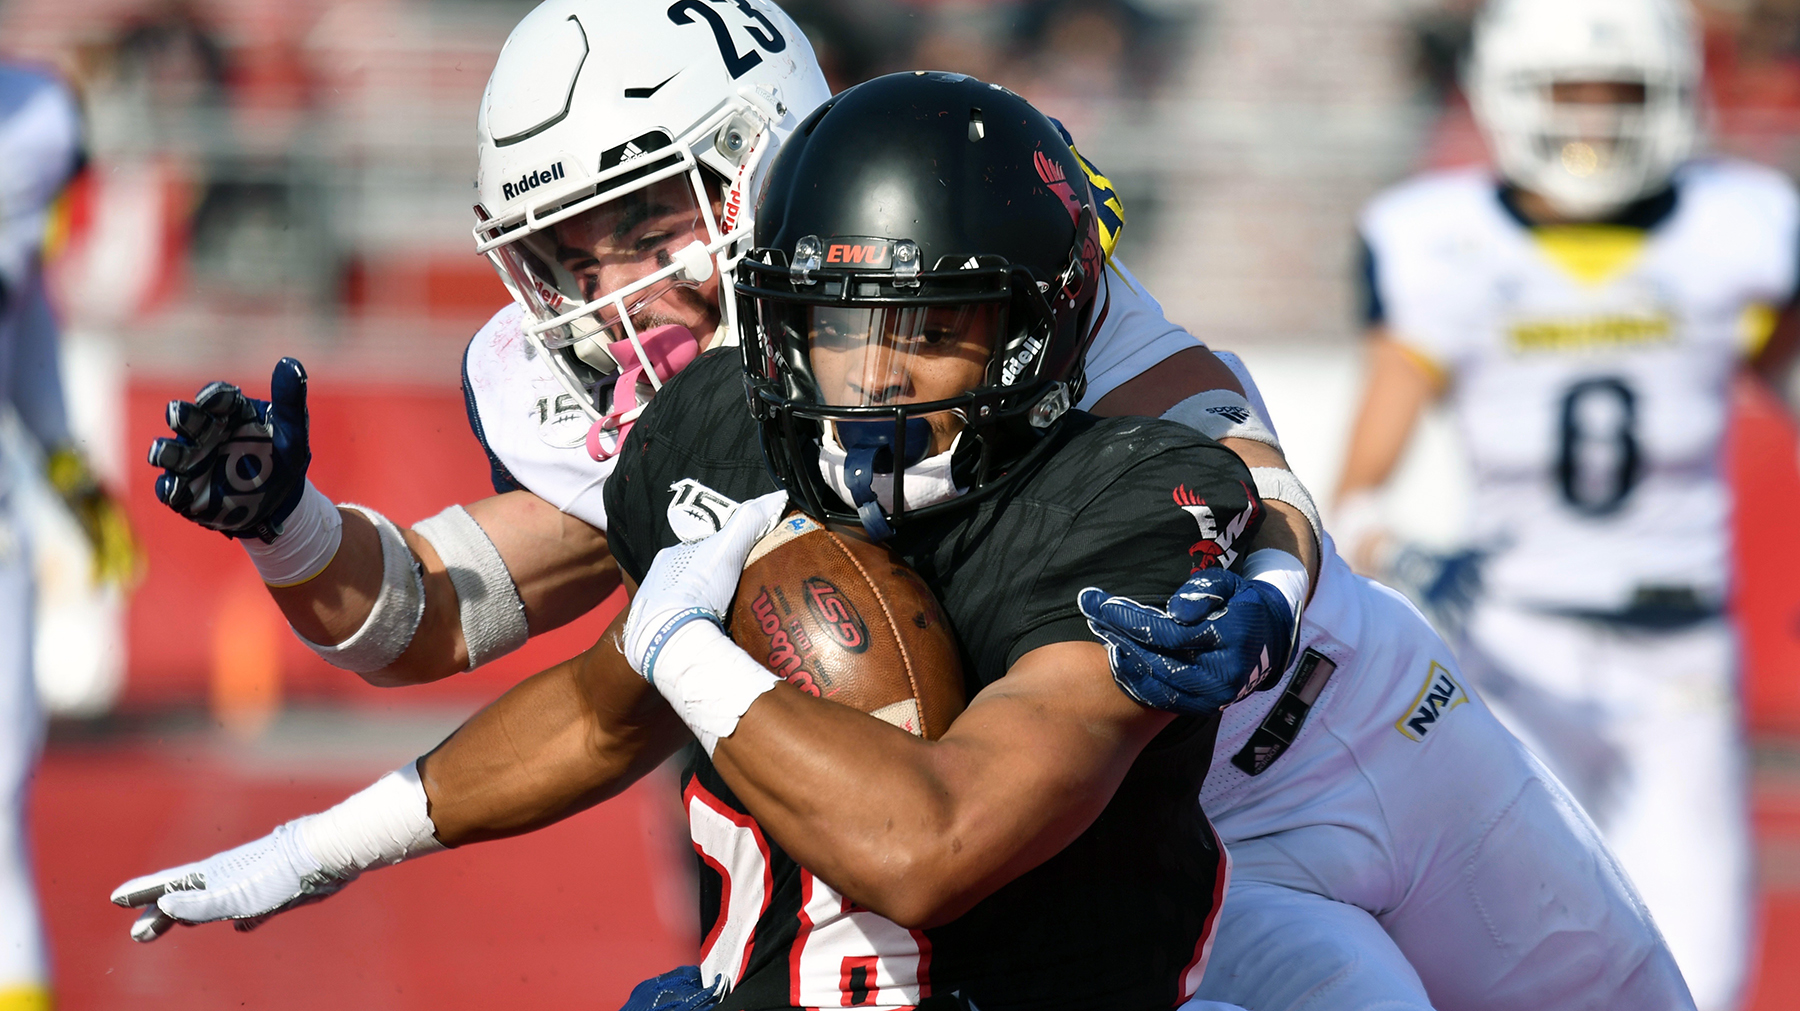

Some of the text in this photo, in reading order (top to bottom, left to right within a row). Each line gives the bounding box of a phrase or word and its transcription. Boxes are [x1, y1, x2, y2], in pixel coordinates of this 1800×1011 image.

[667, 0, 787, 80] 23
[502, 161, 565, 201] Riddell
[826, 244, 888, 264] EWU
[807, 583, 861, 648] GST
[1407, 674, 1456, 737] NAU
